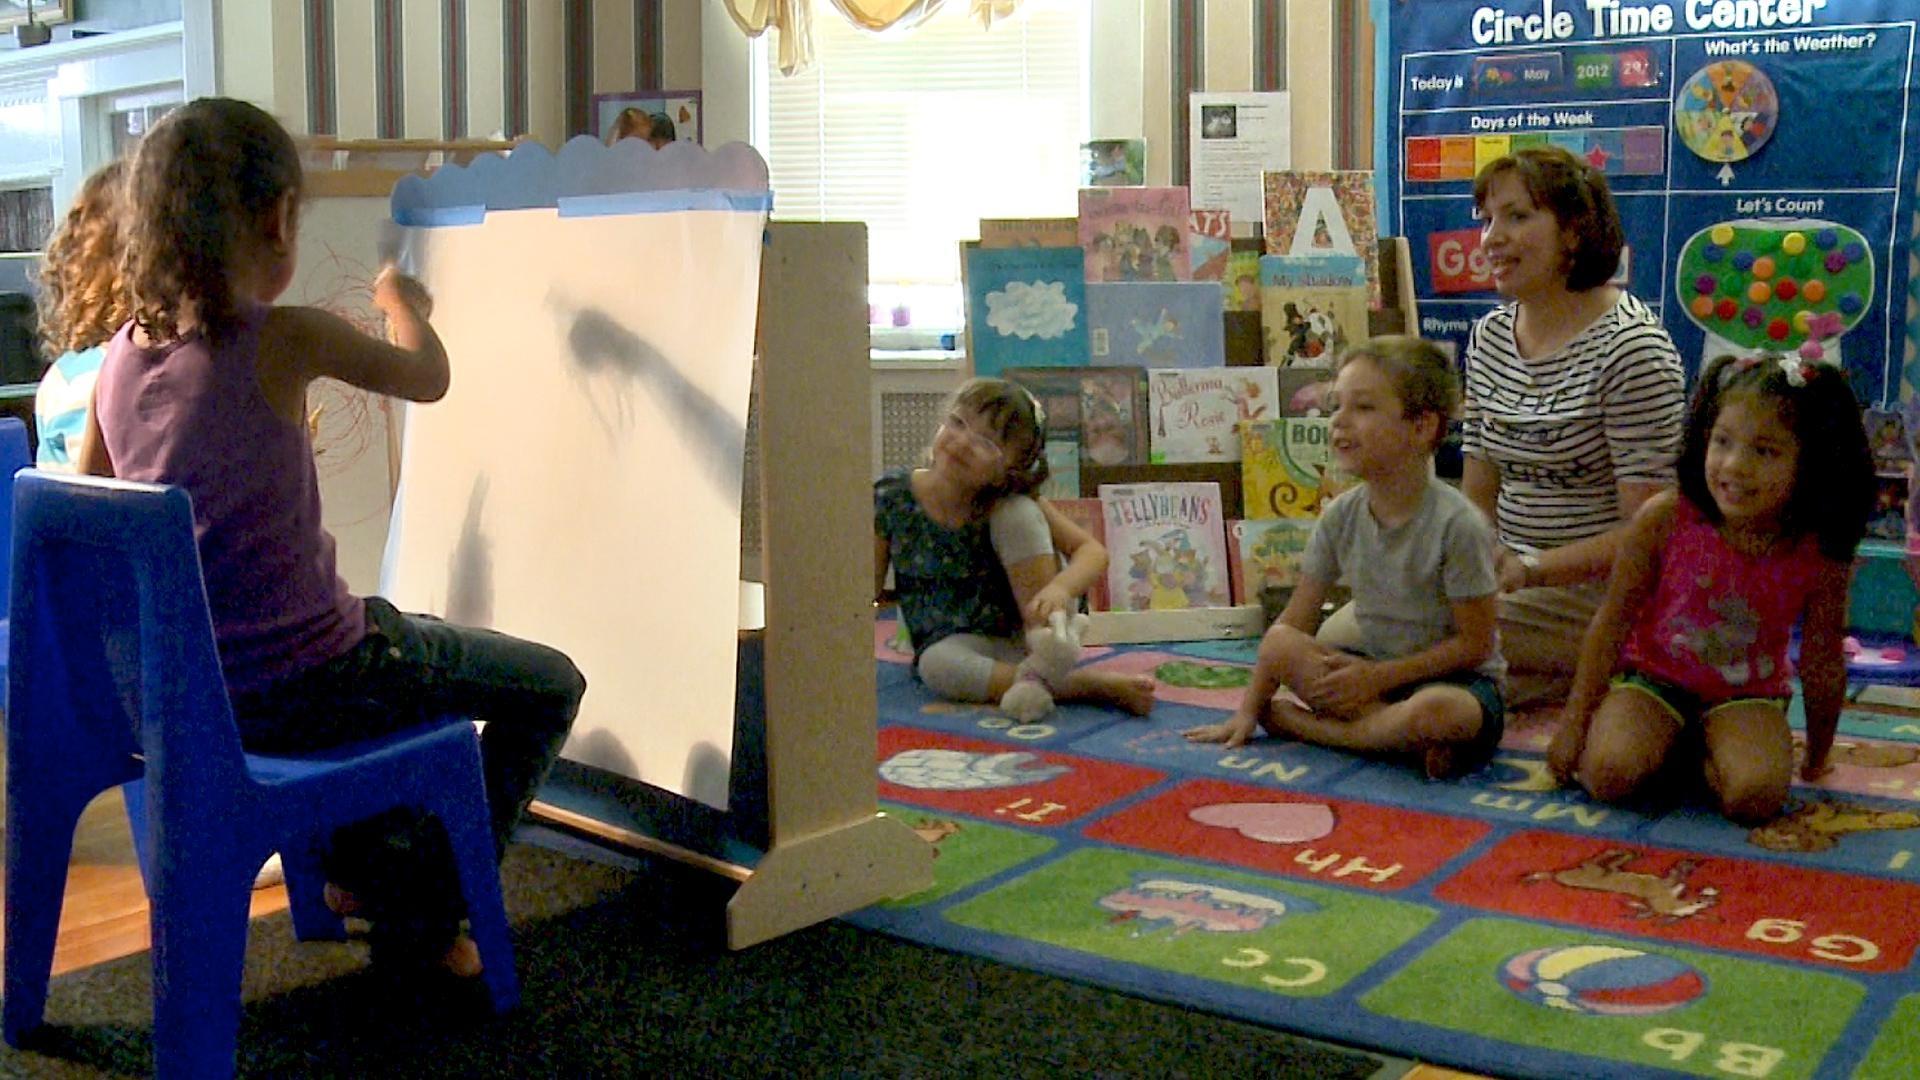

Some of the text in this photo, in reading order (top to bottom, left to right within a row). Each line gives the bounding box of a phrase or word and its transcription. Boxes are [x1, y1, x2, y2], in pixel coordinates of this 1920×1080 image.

[1472, 0, 1826, 45] Circle Time Center
[1705, 31, 1877, 56] What's the Weather?
[1524, 68, 1550, 82] May
[1576, 63, 1609, 79] 2012
[1410, 74, 1453, 92] Today
[1470, 110, 1594, 130] Days of the Week
[1736, 198, 1825, 213] Let's Count
[1288, 187, 1359, 257] A
[1423, 317, 1468, 333] Rhyme
